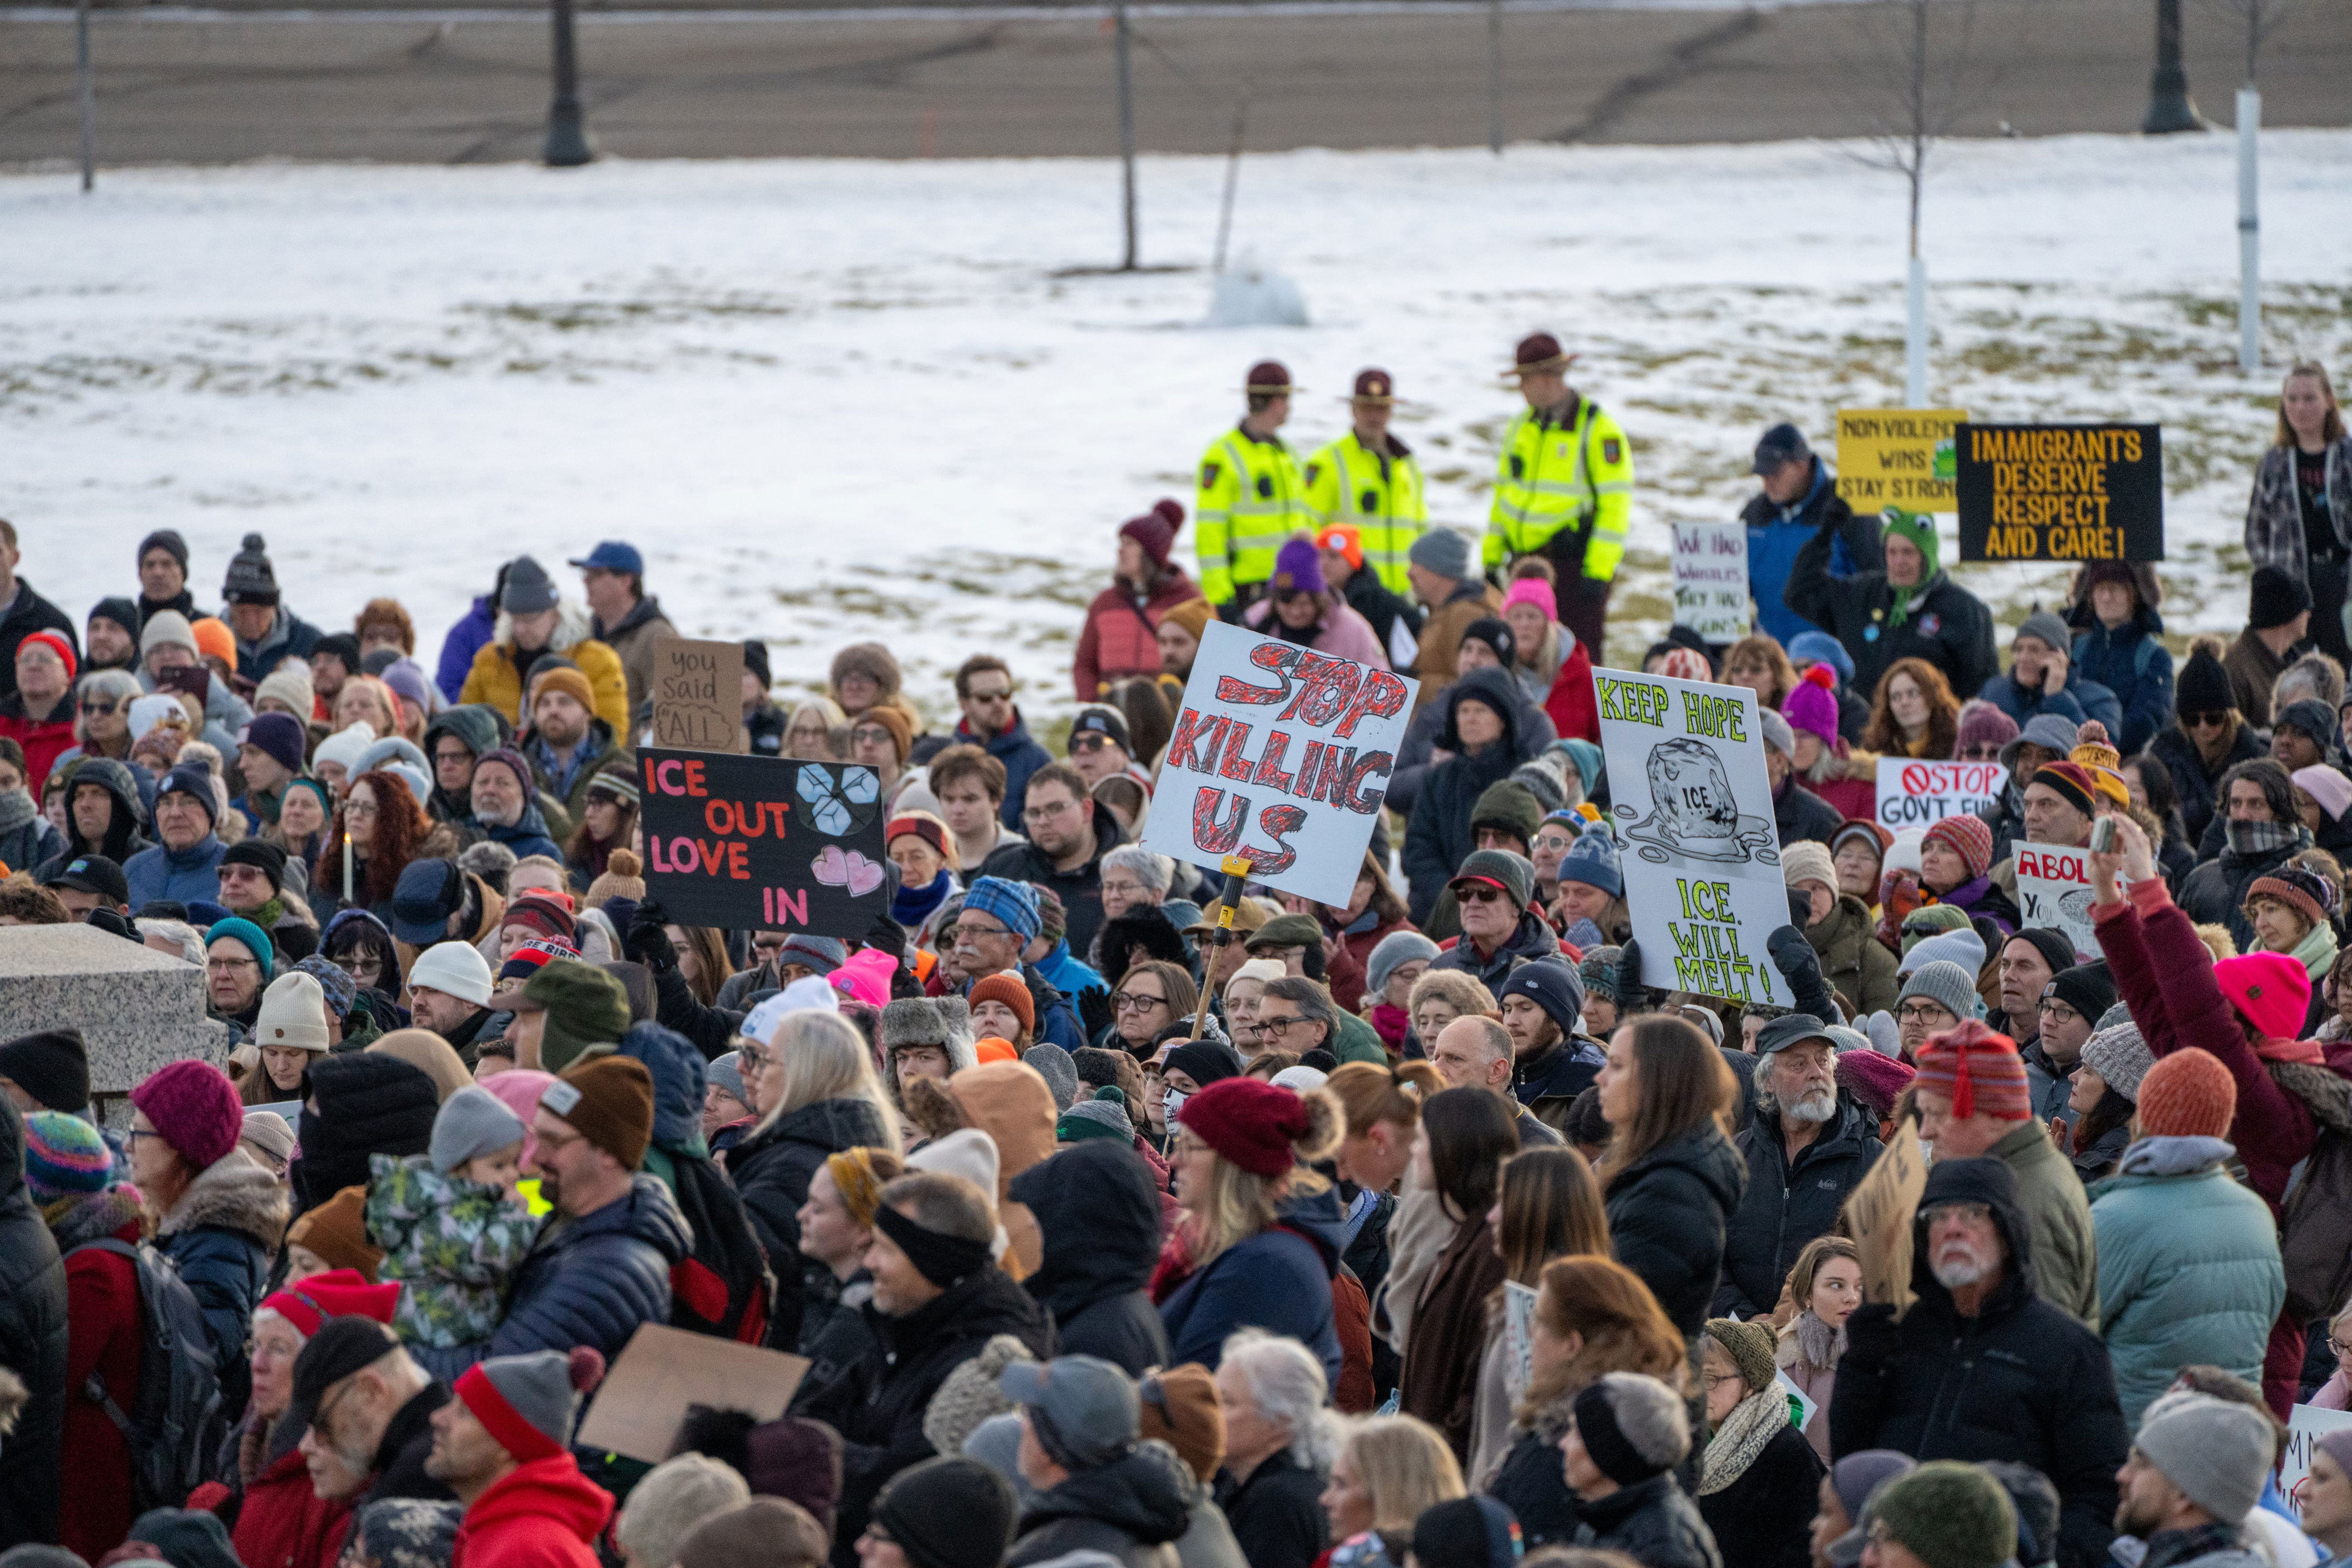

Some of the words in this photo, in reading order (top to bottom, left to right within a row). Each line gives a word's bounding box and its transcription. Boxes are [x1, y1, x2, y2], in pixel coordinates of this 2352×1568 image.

[1878, 449, 1926, 469] WINS
[1971, 429, 2143, 463] IMMIGRANTS
[1841, 476, 1884, 498] STAY
[1891, 476, 1956, 498] STRON
[1992, 461, 2108, 493] DESERVE
[1992, 494, 2110, 526] RESPECT
[1985, 526, 2038, 558] AND
[2047, 526, 2126, 558] CARE!
[1215, 642, 1408, 740] STOP
[1596, 677, 1669, 728] KEEP
[1681, 689, 1746, 743] HOPE
[644, 757, 709, 797] ICE
[1166, 707, 1394, 815] KILLING
[1930, 764, 1999, 796] STOP
[705, 798, 790, 839] OUT
[1881, 795, 1950, 824] GOVT
[1192, 786, 1308, 877] US
[650, 835, 752, 880] LOVE
[763, 886, 809, 926] IN
[1676, 878, 1742, 925] I.C.E.
[1668, 922, 1749, 964] WILL
